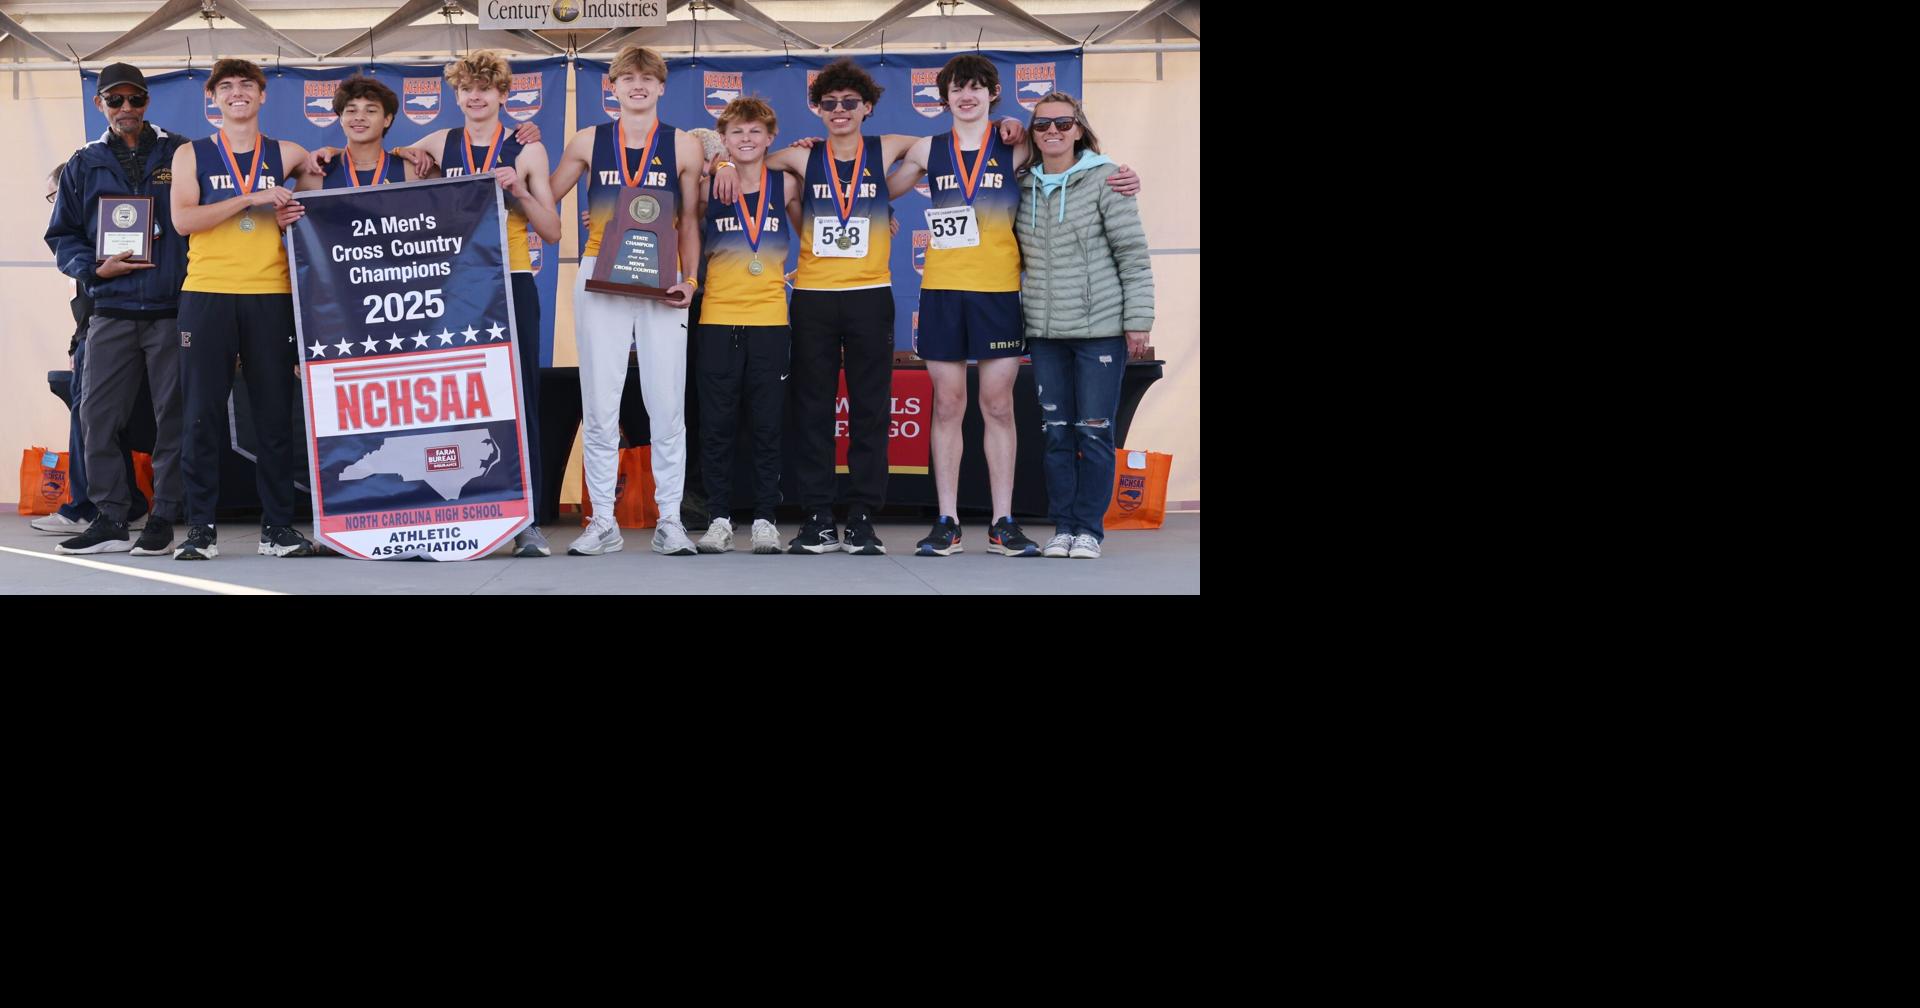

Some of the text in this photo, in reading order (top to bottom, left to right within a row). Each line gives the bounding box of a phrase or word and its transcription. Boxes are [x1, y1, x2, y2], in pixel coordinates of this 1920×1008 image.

[487, 0, 658, 24] Century Industries
[351, 213, 437, 236] 2A Men's
[932, 216, 968, 237] 537
[332, 235, 463, 262] Cross Country
[349, 261, 451, 284] Champions
[363, 288, 445, 324] 2025
[335, 371, 492, 431] NCHSAA
[835, 397, 921, 415] WLS
[834, 420, 921, 438] FGO
[345, 503, 503, 530] NORTH CAROLINA HIGH SCHOOL
[389, 527, 461, 543] ATHLETIC
